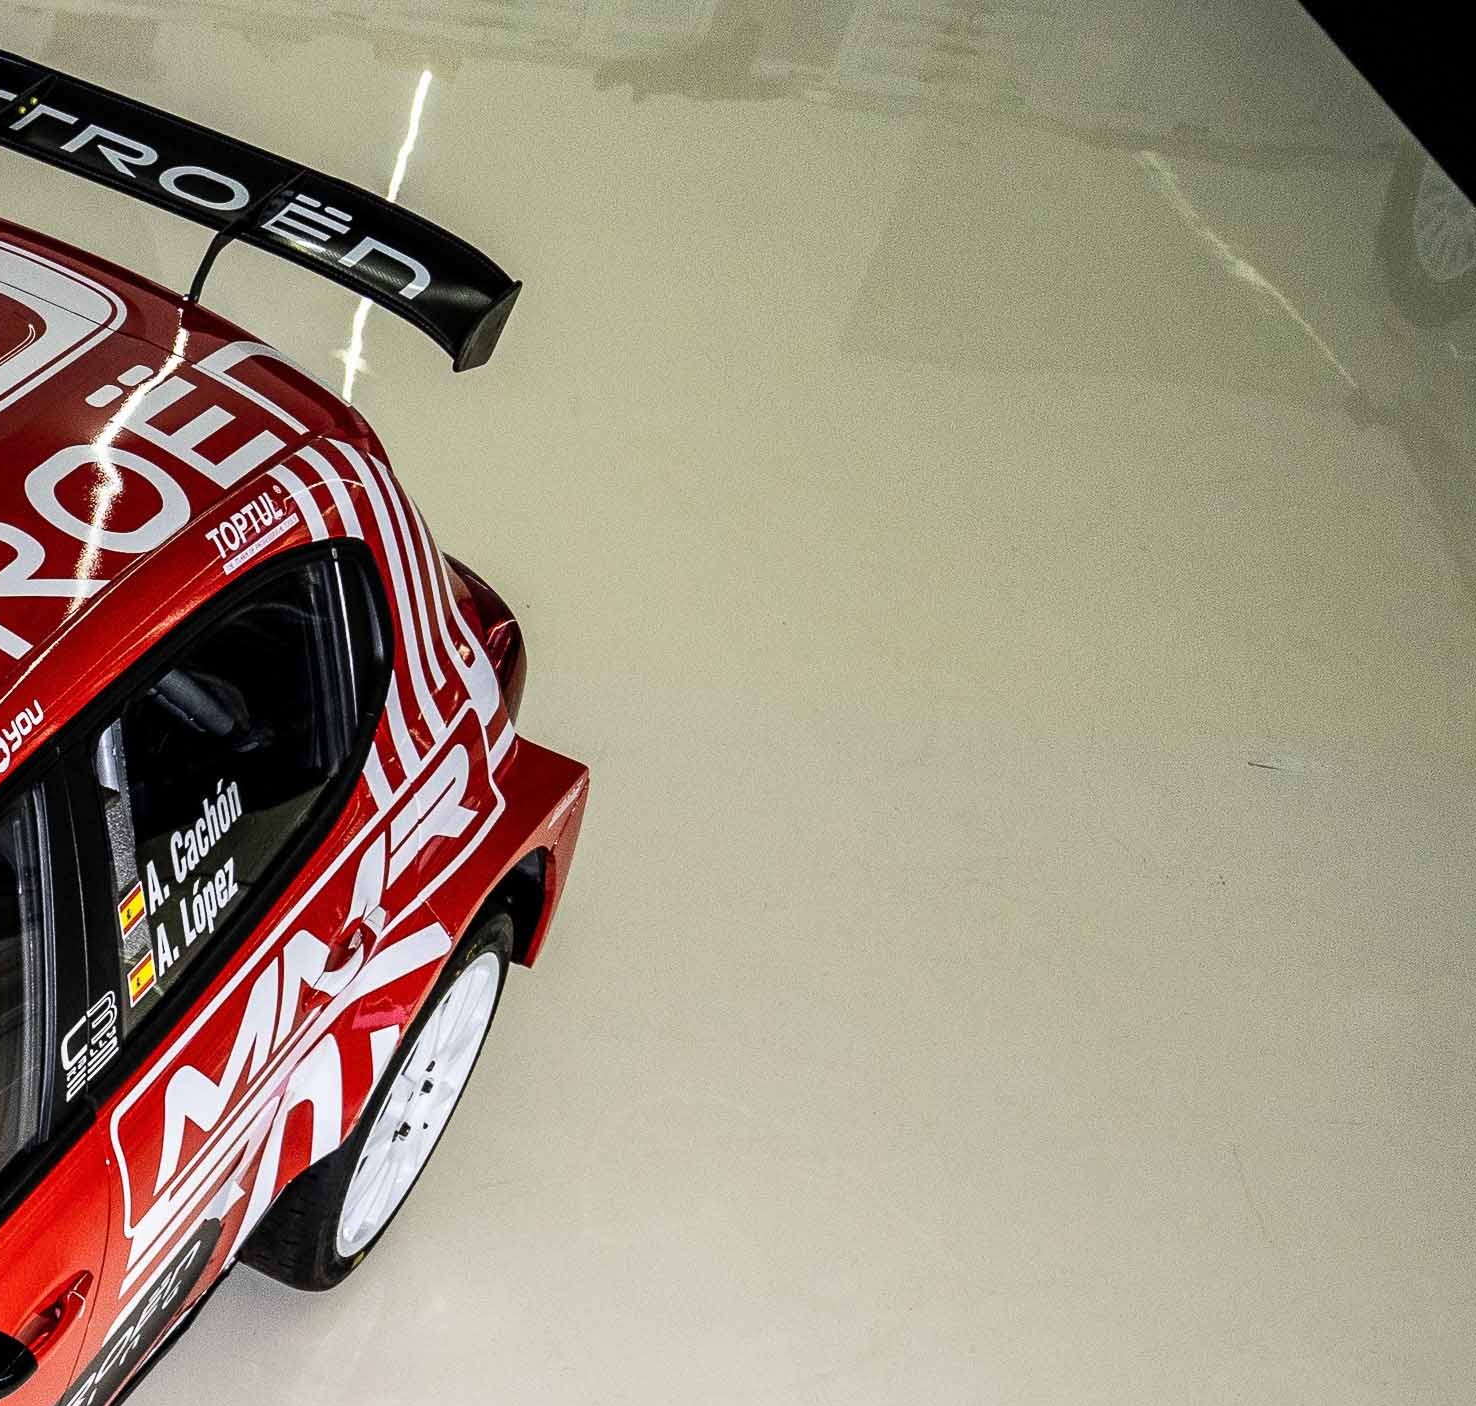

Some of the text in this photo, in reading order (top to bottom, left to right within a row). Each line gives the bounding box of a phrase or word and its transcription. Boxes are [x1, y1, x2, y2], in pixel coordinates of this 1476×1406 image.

[145, 777, 243, 914] A. Cachón
[156, 857, 239, 977] A. López
